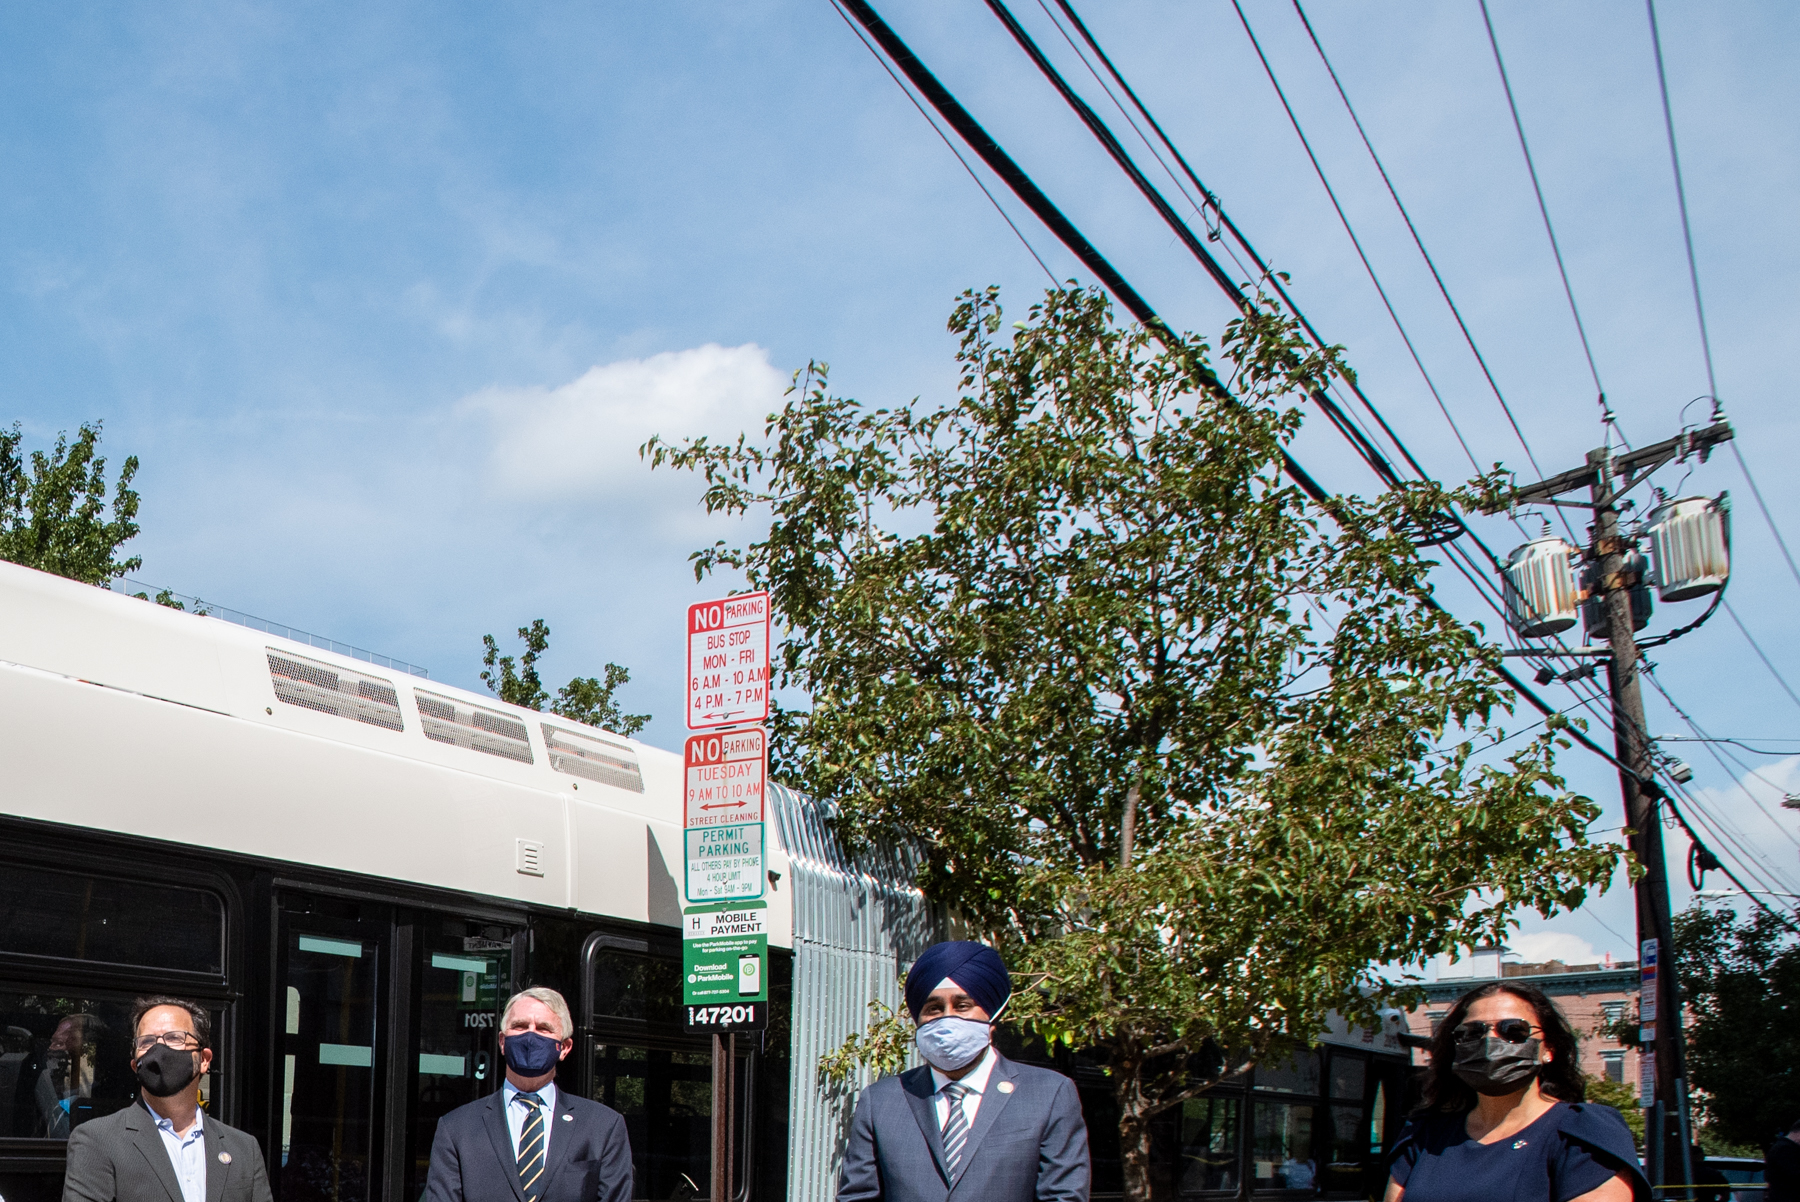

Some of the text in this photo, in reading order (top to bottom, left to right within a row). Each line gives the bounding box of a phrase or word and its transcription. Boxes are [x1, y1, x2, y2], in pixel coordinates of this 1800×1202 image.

[694, 600, 763, 630] NO PARKING
[707, 630, 751, 650] BUS STOP
[703, 656, 726, 670] MON
[739, 649, 755, 664] FRI
[692, 678, 698, 691] 6
[702, 674, 720, 690] A.M
[733, 671, 744, 686] 10
[694, 696, 702, 710] 4
[706, 692, 724, 709] P.M
[736, 691, 742, 705] 7
[746, 688, 763, 703] P.M
[691, 737, 761, 764] NO PARKING
[697, 763, 752, 782] TUESDAY
[689, 782, 760, 802] 9 AM TO 10 AM
[690, 812, 759, 826] STREET CLEANING
[703, 828, 744, 842] PERMIT
[699, 842, 750, 858] PARKING
[691, 856, 759, 872] ALL OTHERS PAY BY PHONE
[707, 870, 741, 882] 4 HOUR LIMIT
[697, 888, 708, 896] Mon
[714, 886, 722, 894] Sat
[724, 884, 735, 894] 9AM
[741, 882, 752, 892] 9PM
[692, 917, 700, 930] H
[716, 912, 756, 924] MOBILE
[710, 922, 762, 934] PAYMENT
[694, 963, 727, 972] Download
[698, 974, 734, 982] ParkMobile
[696, 1005, 754, 1024] 47201
